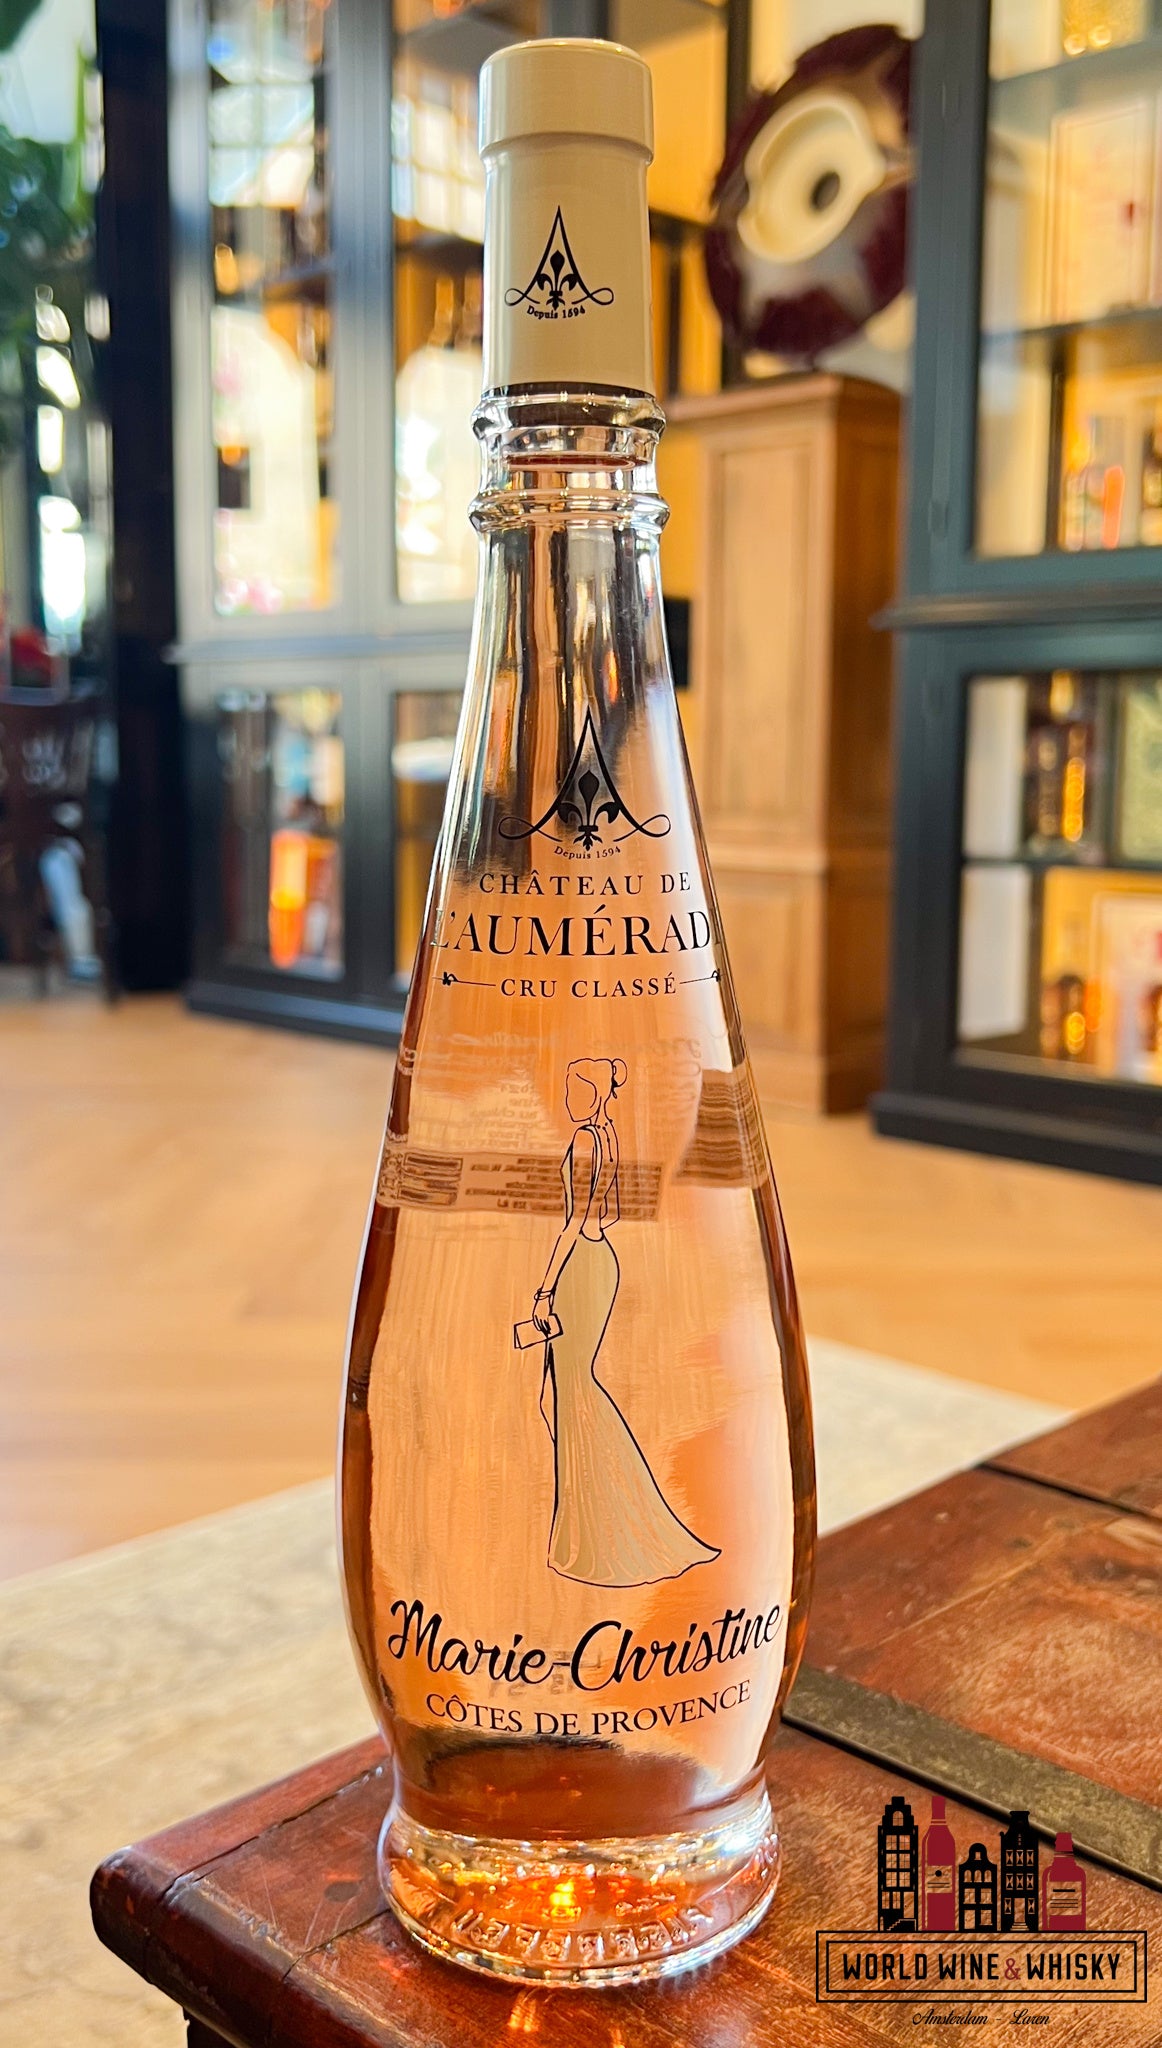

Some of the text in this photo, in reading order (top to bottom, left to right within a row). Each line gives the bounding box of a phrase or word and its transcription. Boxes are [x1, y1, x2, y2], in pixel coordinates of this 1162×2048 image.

[526, 304, 586, 320] Depuis 1594
[553, 845, 621, 860] Depuis 1594
[479, 869, 692, 896] CHÂTEAU DE
[500, 972, 677, 998] CRU CLASSÉ
[387, 1598, 782, 1692] Marie-Christine
[426, 1679, 752, 1737] CÔTES DE PROVENCE
